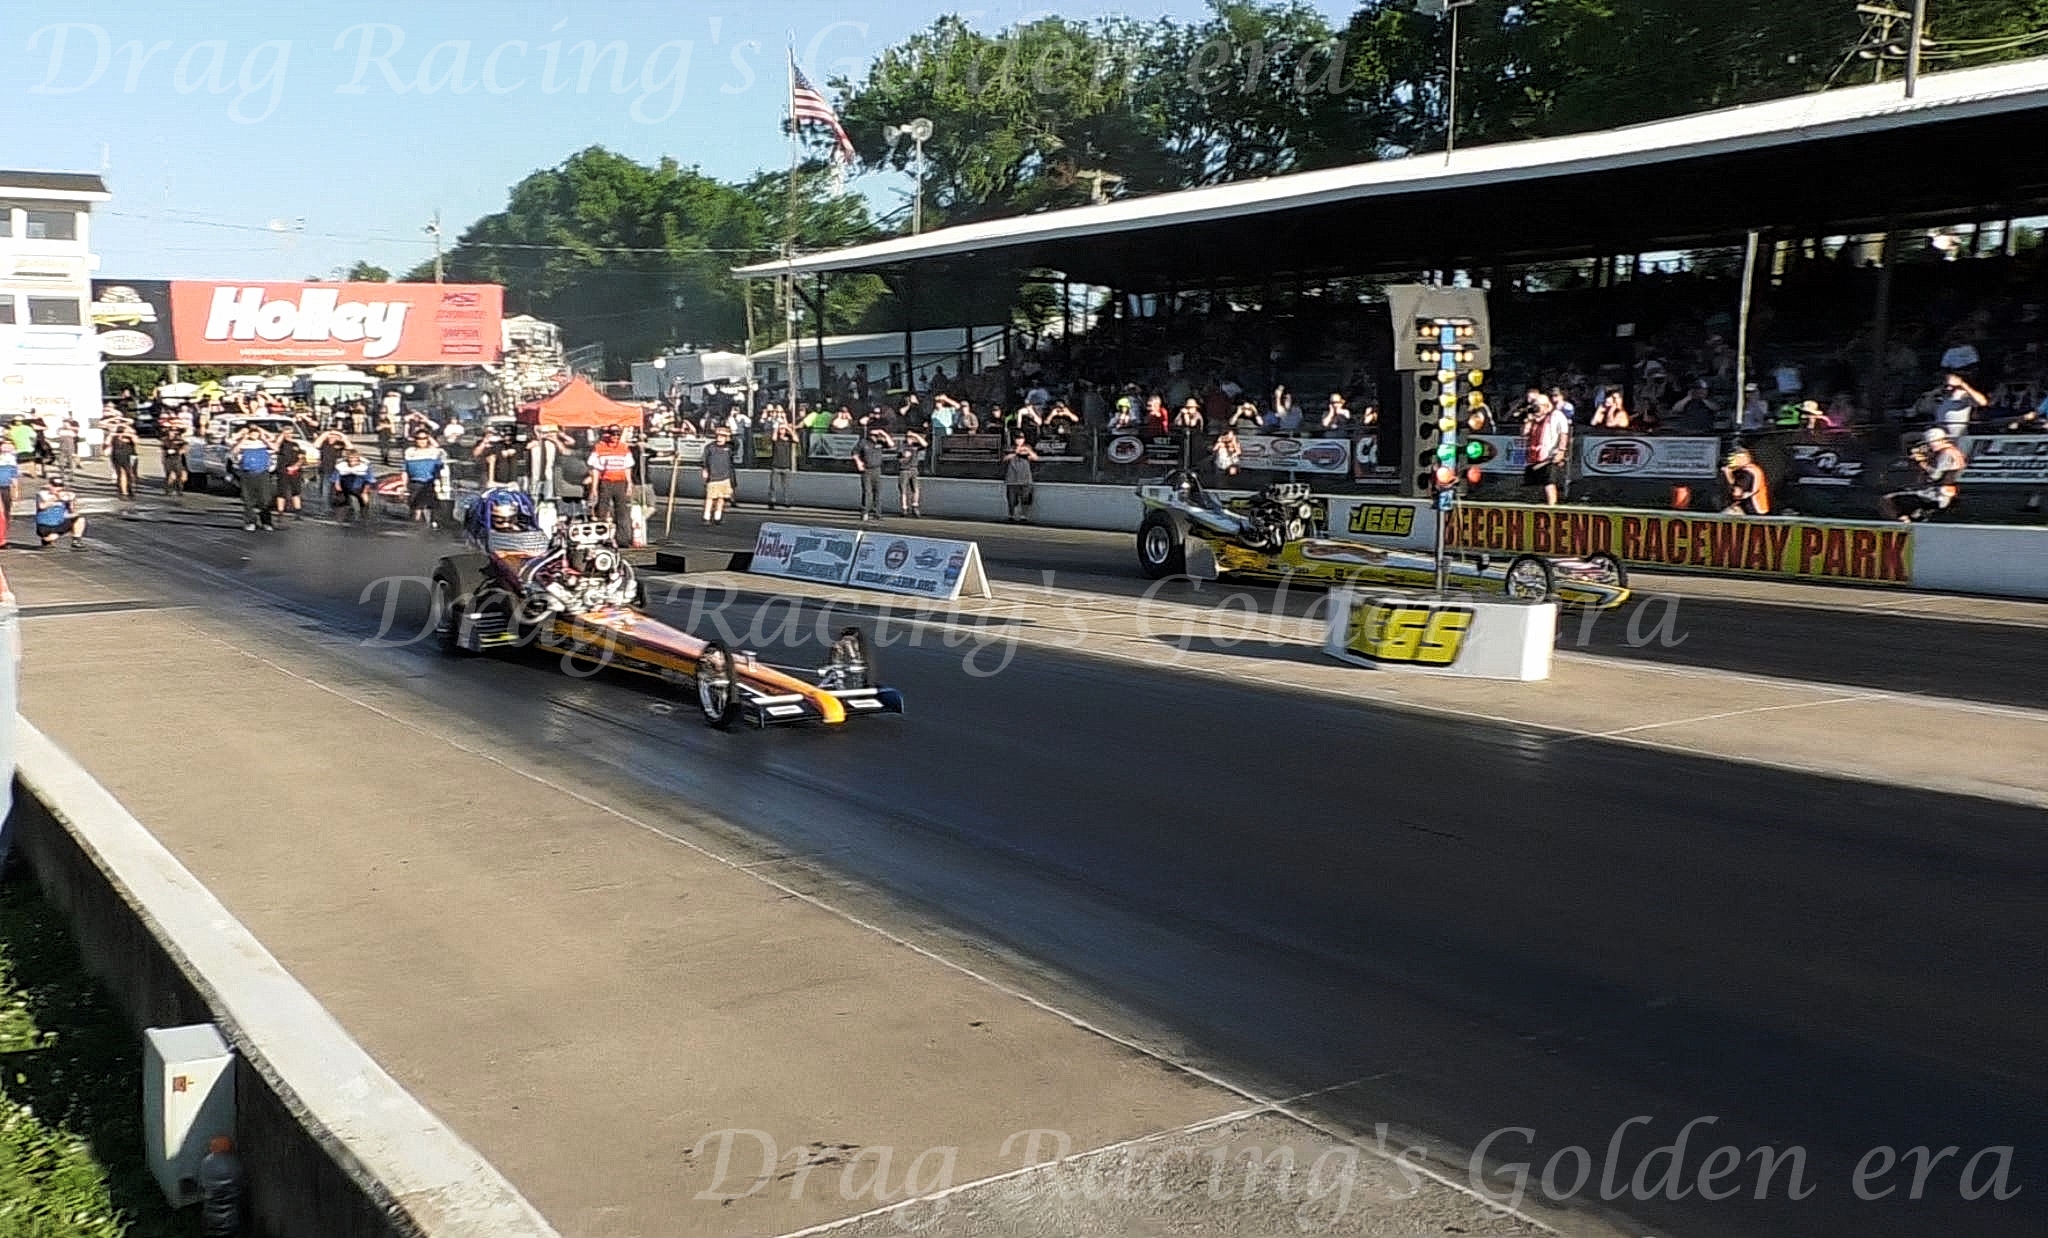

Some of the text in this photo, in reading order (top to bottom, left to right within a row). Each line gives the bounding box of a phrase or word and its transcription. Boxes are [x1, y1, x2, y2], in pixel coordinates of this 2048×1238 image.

[204, 286, 413, 359] Holley
[1350, 505, 1414, 536] JEGS
[1533, 511, 1612, 556] BEND
[1622, 516, 1791, 572] RACEWAY
[1801, 527, 1908, 582] PARK
